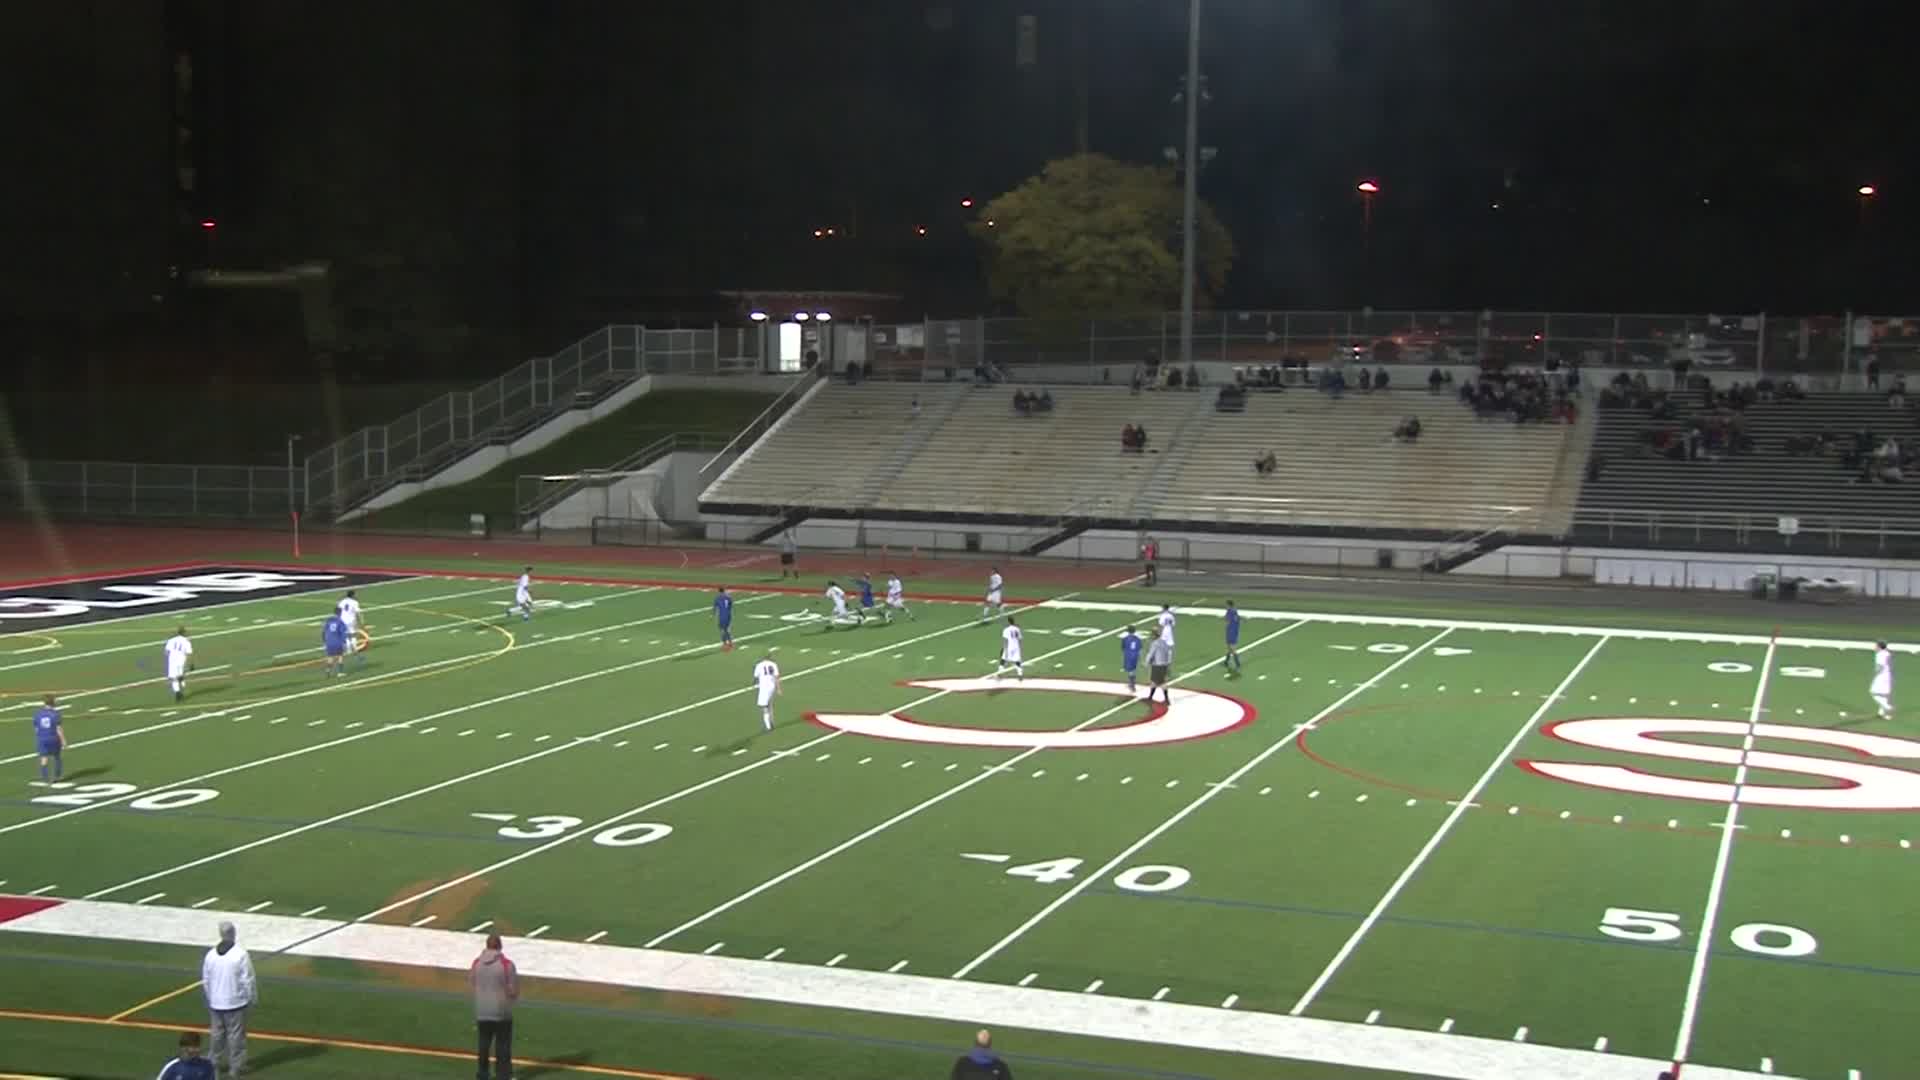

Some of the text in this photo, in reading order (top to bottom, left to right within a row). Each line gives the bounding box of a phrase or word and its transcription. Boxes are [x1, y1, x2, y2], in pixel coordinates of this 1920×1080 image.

[30, 783, 221, 810] 20
[498, 815, 673, 847] 30
[1006, 857, 1192, 892] 40
[1598, 907, 1818, 957] 50
